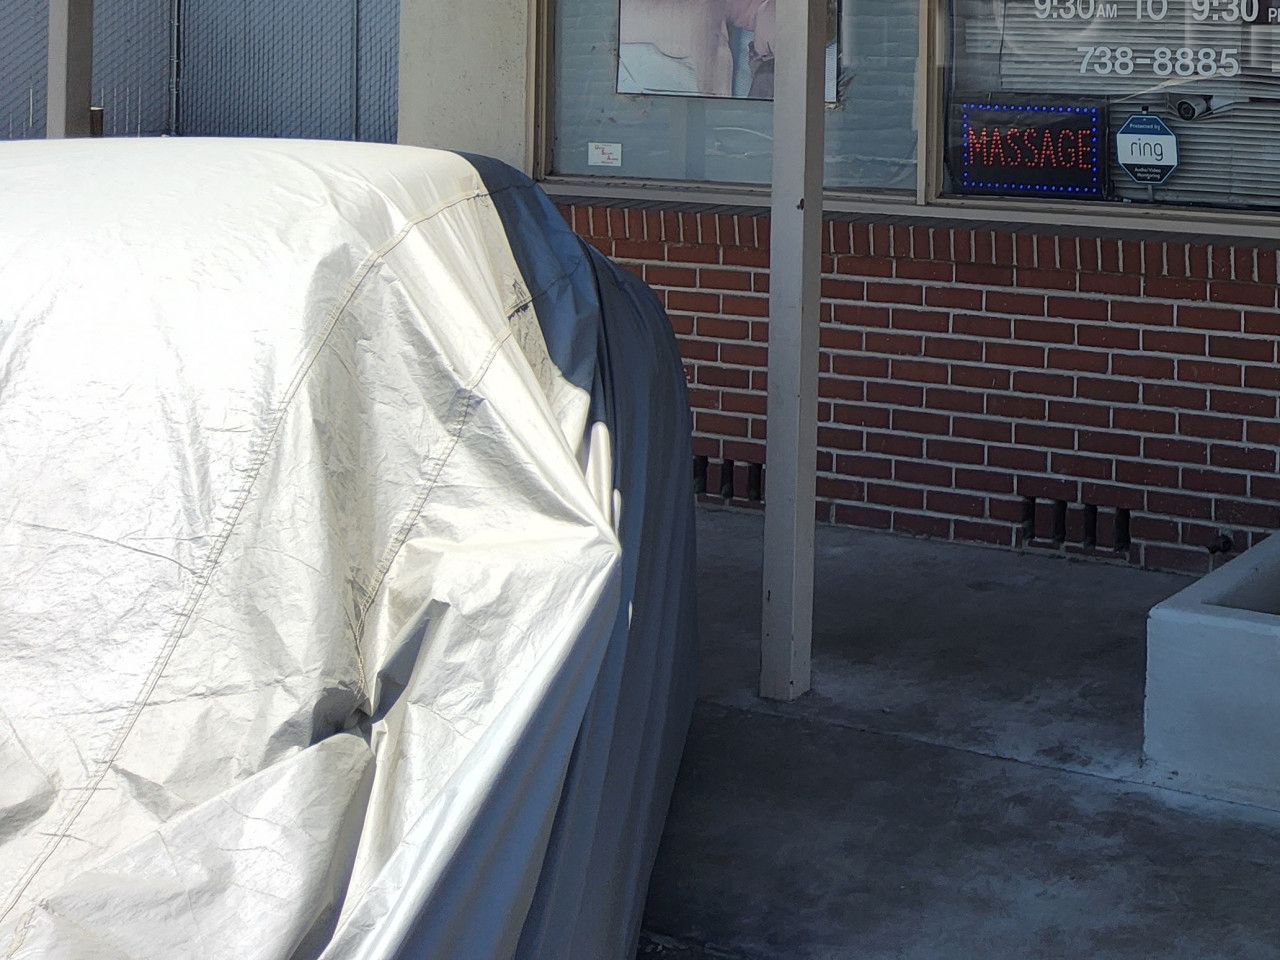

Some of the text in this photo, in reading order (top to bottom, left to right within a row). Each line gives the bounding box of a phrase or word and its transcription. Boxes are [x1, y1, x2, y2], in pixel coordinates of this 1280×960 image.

[1076, 46, 1240, 77] 738-8885
[969, 127, 1092, 169] MASSAGE
[1130, 138, 1163, 161] ring
